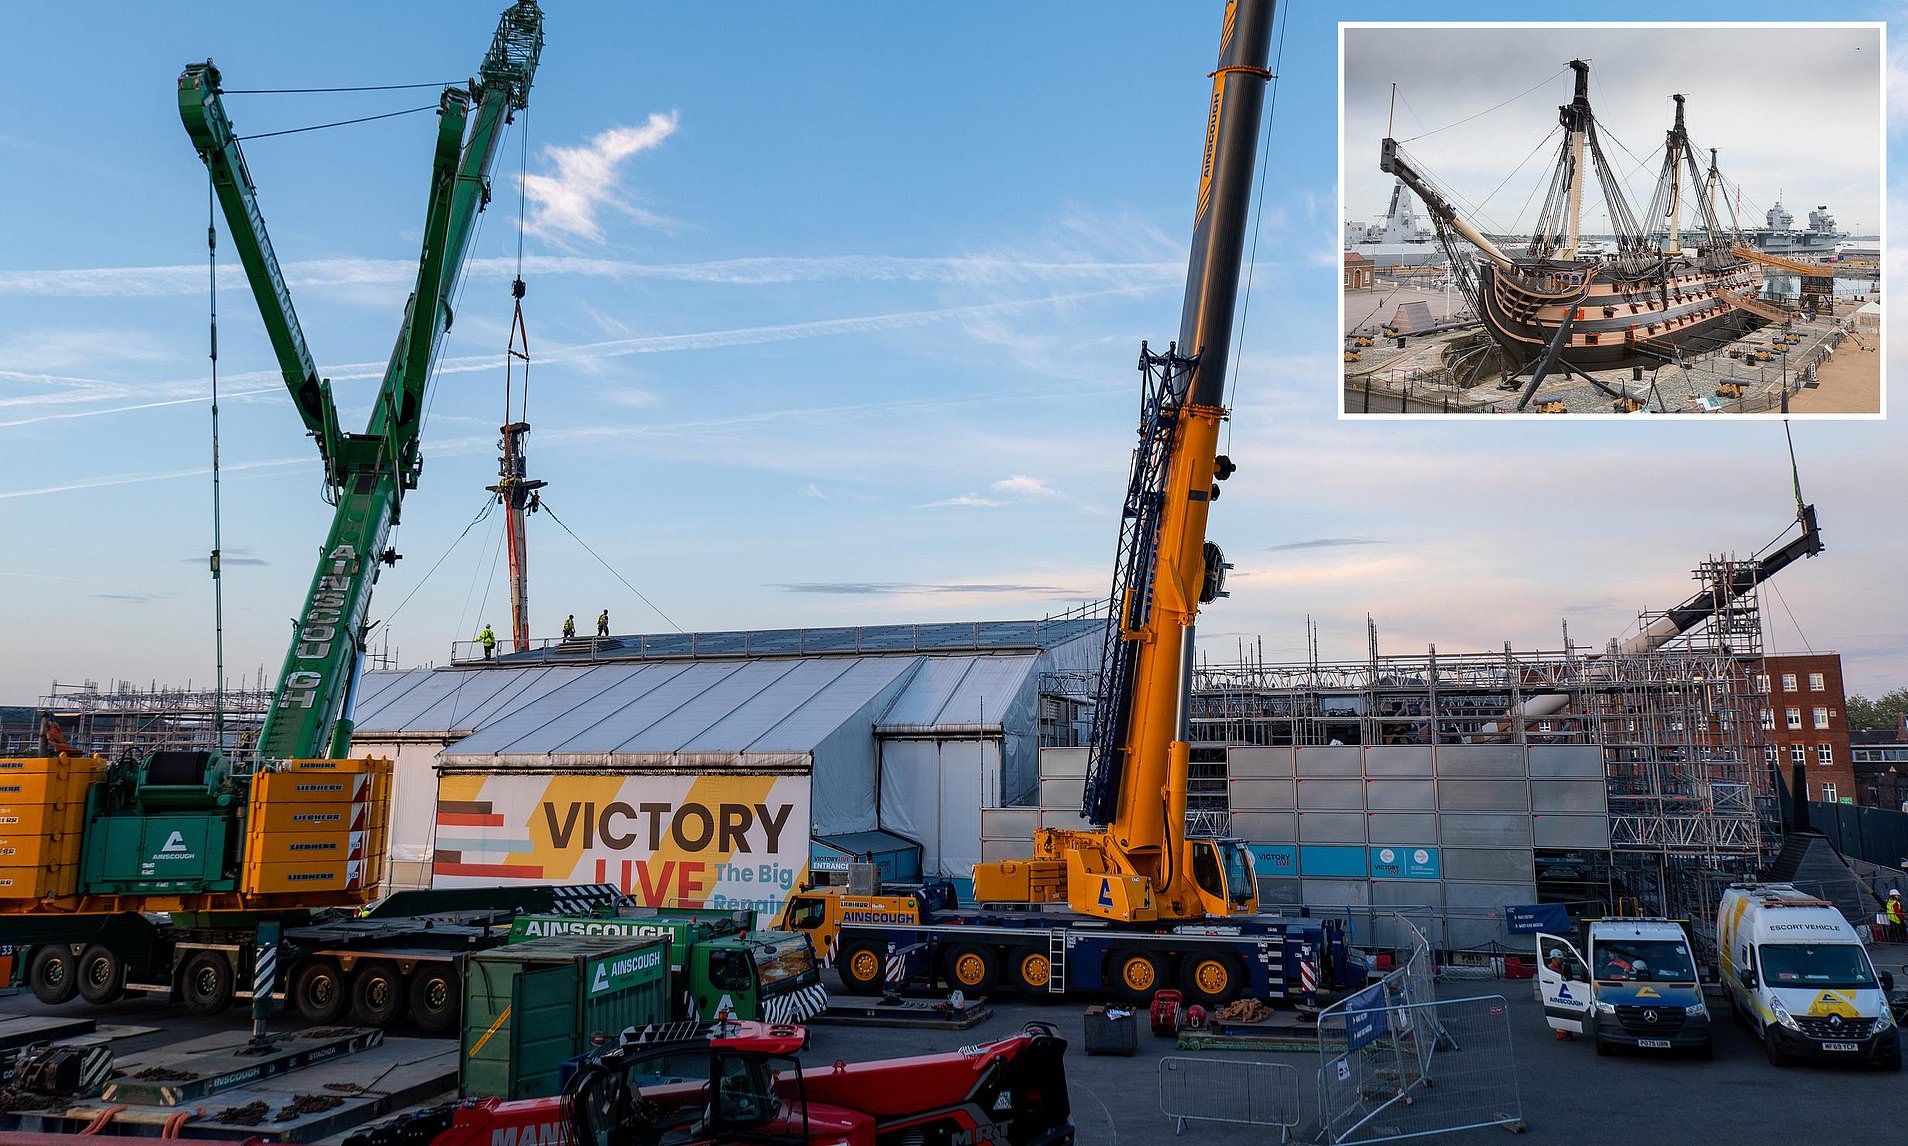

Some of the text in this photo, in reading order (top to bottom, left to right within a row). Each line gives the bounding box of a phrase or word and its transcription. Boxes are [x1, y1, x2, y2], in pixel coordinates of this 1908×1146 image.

[1203, 93, 1220, 179] AINSCOUGH
[243, 194, 302, 341] AINSCOUGH
[277, 544, 356, 709] AINSCOUGH
[543, 801, 794, 854] VICTORY
[714, 862, 755, 882] The
[758, 862, 793, 891] Big
[813, 862, 848, 870] ENTRANCE
[525, 920, 675, 943] AINSCOUGH
[843, 912, 915, 924] AINSCOUGH
[611, 951, 660, 978] AINSCOUGH
[1550, 997, 1584, 1007] AINSCOUGH
[208, 1065, 260, 1087] INSCOUGH
